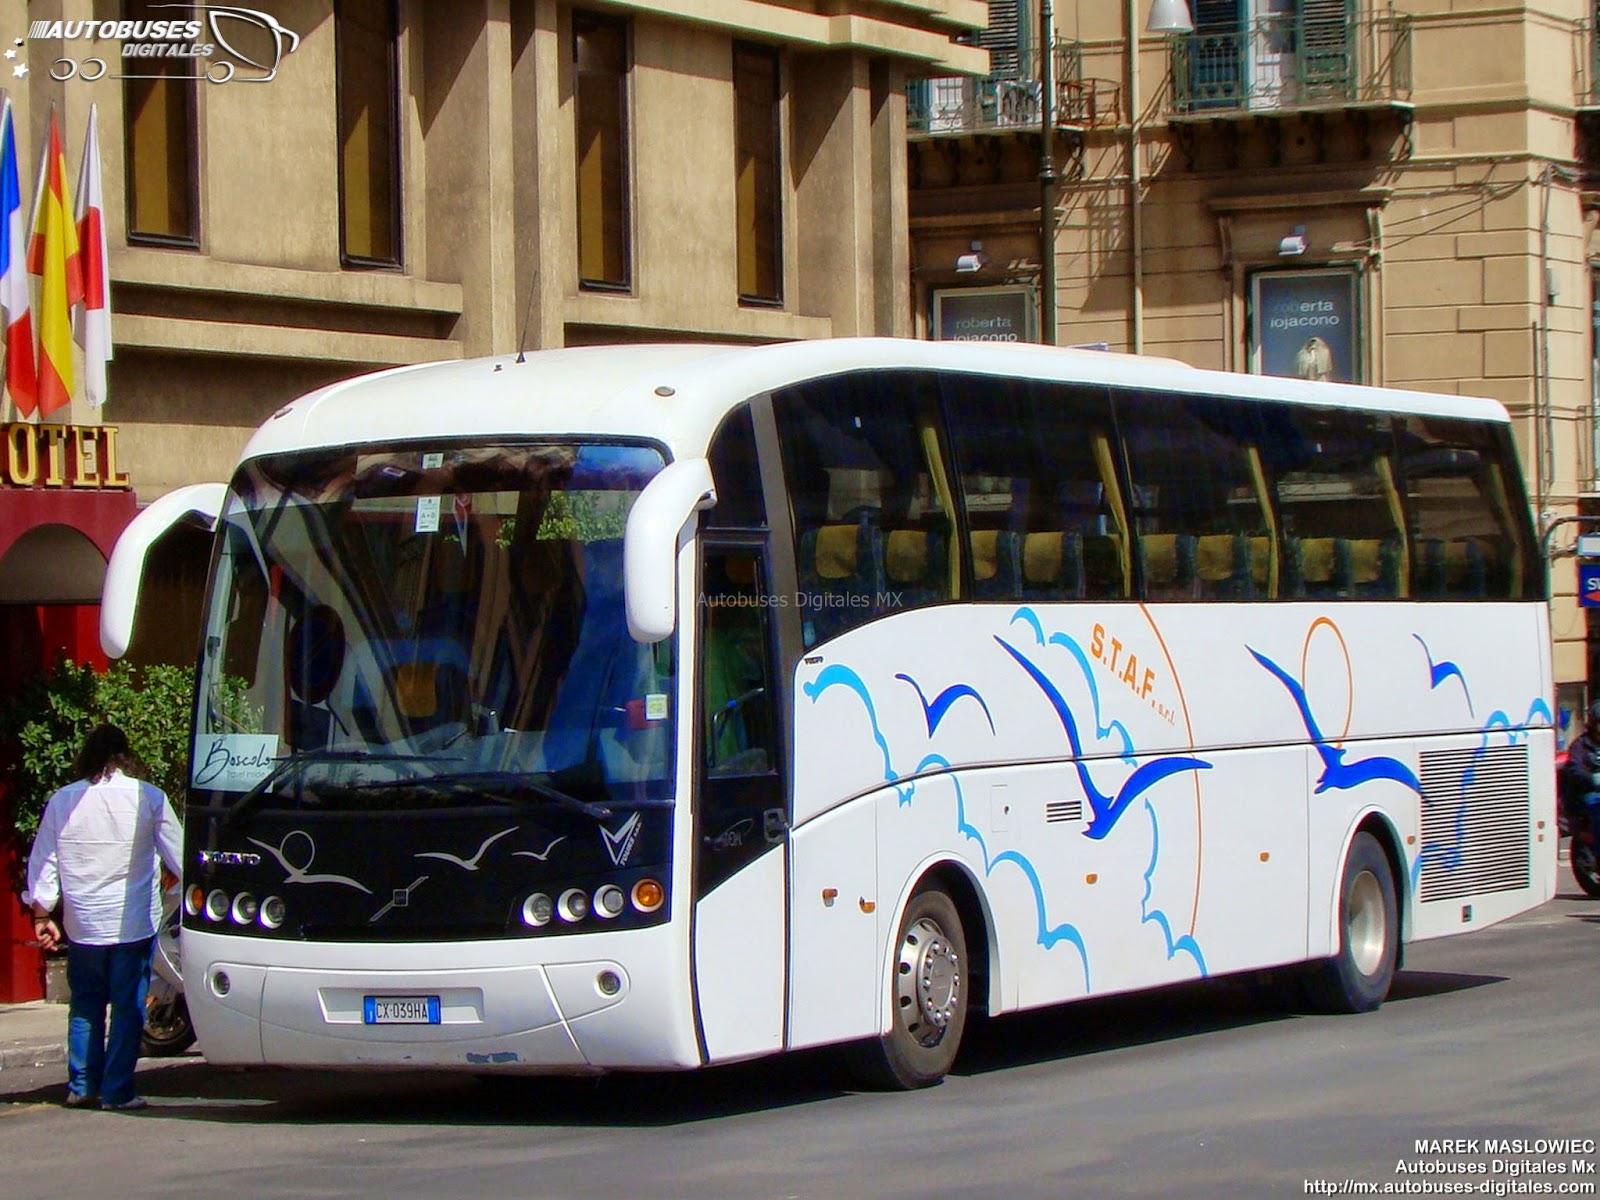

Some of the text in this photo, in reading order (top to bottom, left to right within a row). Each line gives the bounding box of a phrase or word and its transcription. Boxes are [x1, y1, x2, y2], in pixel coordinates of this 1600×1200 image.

[956, 316, 1012, 329] roberta
[0, 423, 130, 486] OTEL
[195, 739, 271, 785] Boscolo
